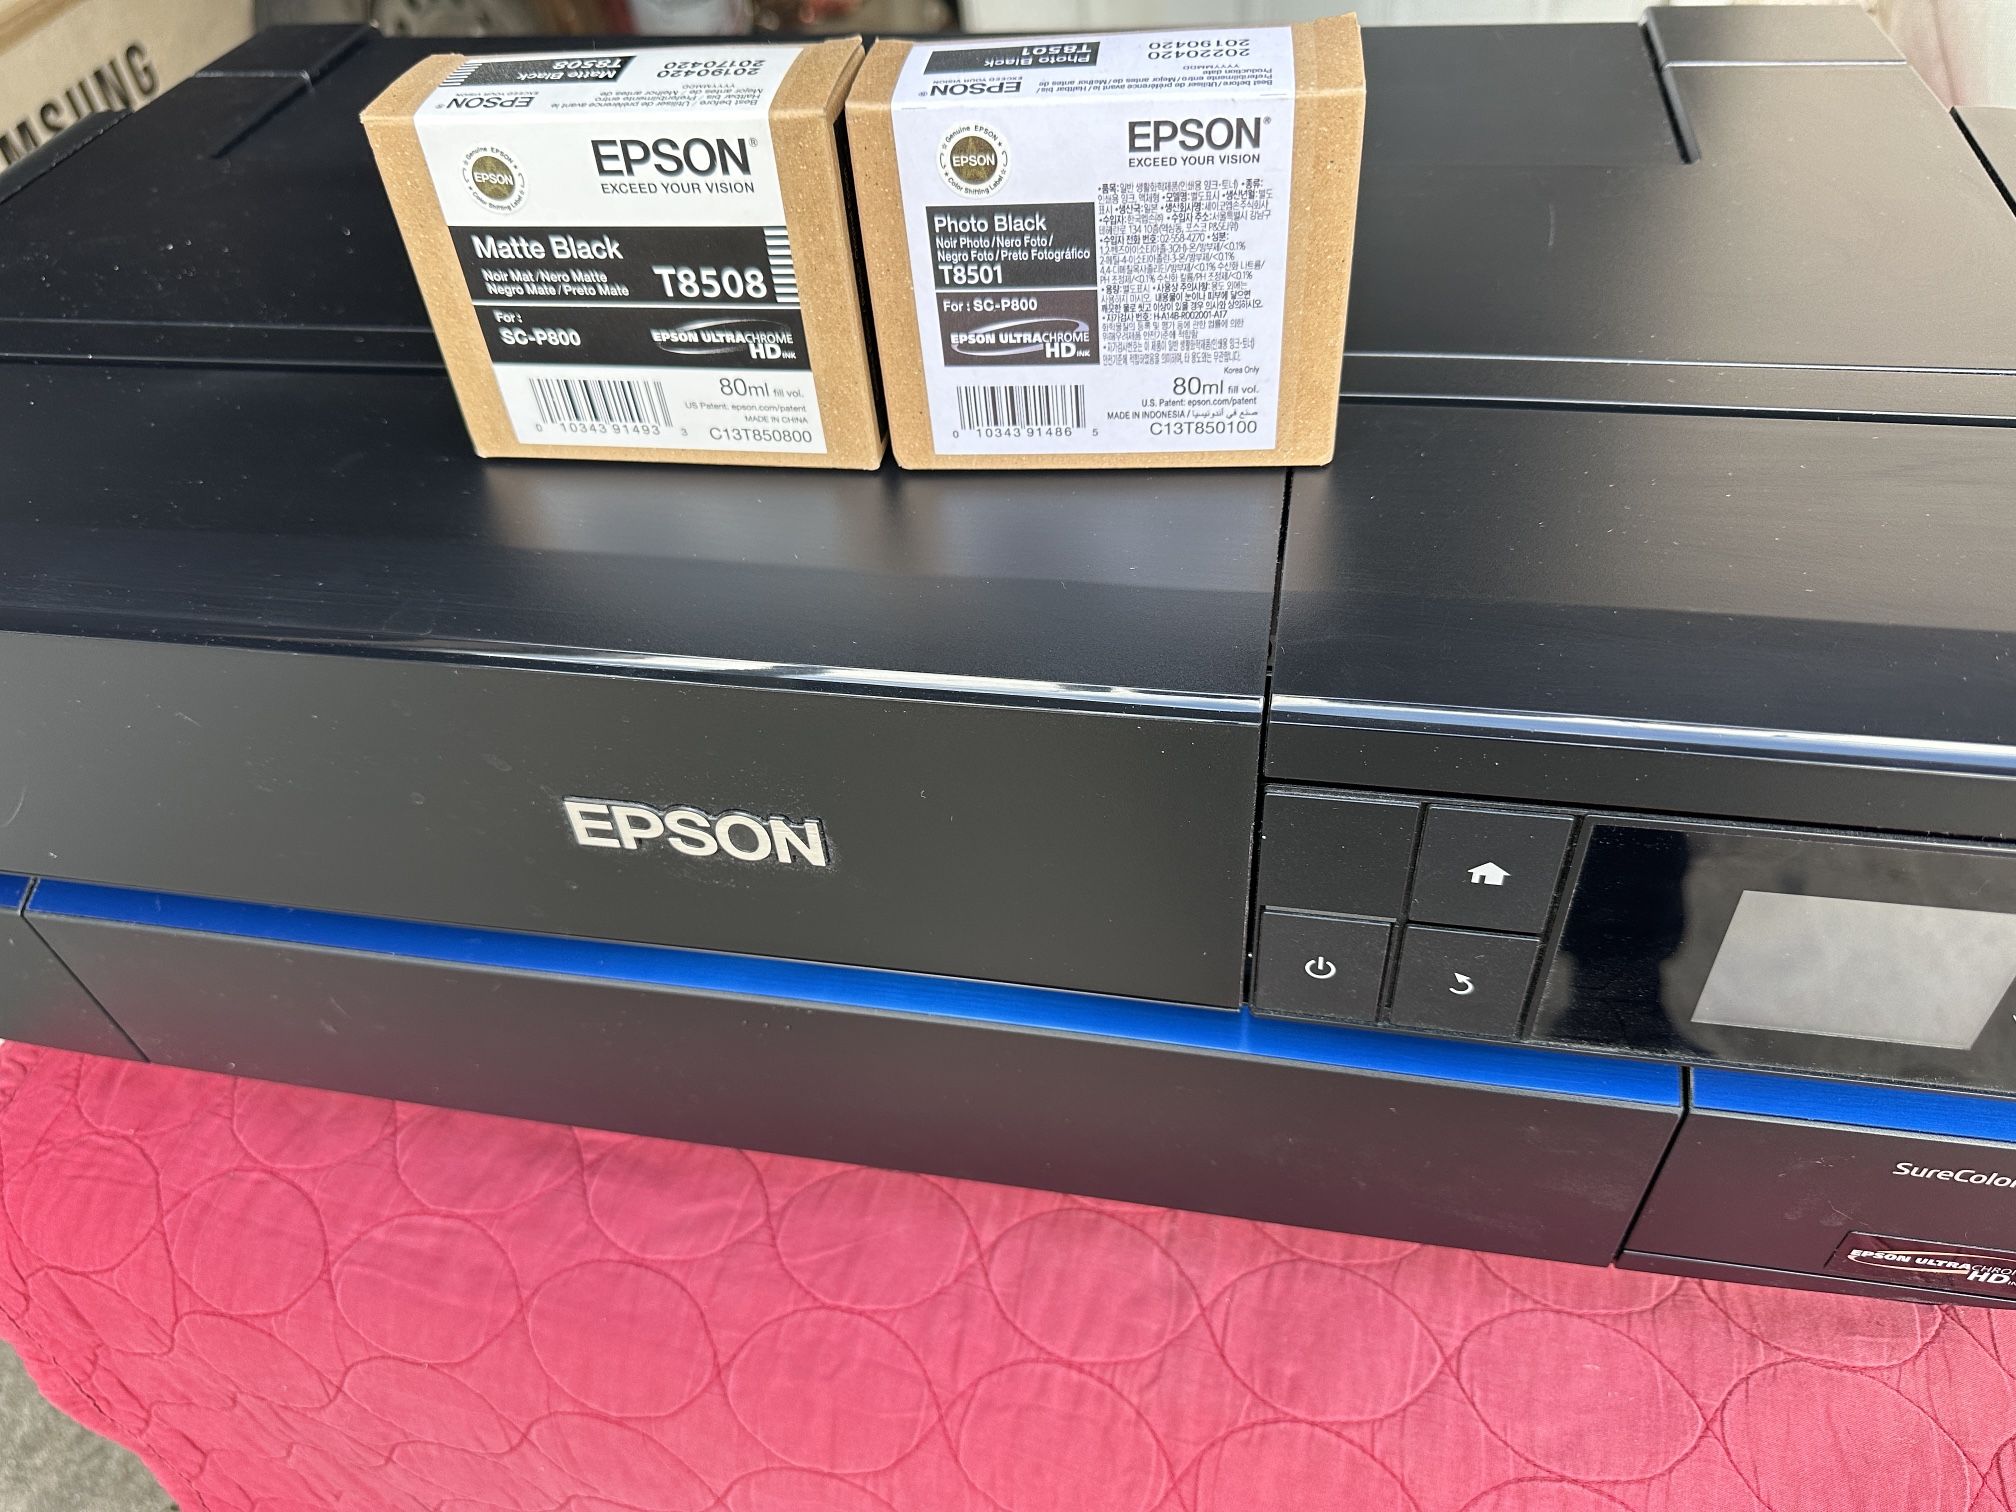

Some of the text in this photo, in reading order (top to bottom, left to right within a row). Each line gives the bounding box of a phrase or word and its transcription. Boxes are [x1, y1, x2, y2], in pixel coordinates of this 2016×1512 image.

[1021, 43, 1092, 56] T8501
[1148, 38, 1250, 50] 20190420
[983, 53, 1090, 68] Photo Black
[1147, 48, 1250, 60] 20220420
[552, 58, 622, 70] T8508
[664, 60, 766, 70] 20170420
[516, 69, 617, 81] Matte Black
[656, 67, 761, 78] 20190420
[945, 124, 999, 143] Genuine EPSON
[952, 153, 996, 167] EPSON
[1128, 153, 1261, 168] EXCEED YOUR VISION
[474, 171, 514, 186] EPSON
[947, 177, 964, 192] Color
[988, 175, 1004, 191] Label
[600, 182, 755, 194] EXCEED YOUR VISION
[934, 211, 1047, 233] Photo Black
[471, 234, 624, 260] Matte Black
[935, 235, 957, 249] Noir
[937, 250, 969, 264] Negro
[1030, 246, 1090, 263] Fotográfico
[480, 268, 508, 282] Noir
[569, 268, 608, 283] Matte
[938, 263, 1003, 285] T8501
[485, 282, 525, 297] Negro
[597, 282, 630, 297] Mate
[651, 265, 767, 299] T8508
[973, 297, 1038, 312] SC-P800
[498, 327, 582, 346] SC-P800
[650, 328, 794, 345] EPSON ULTRACHROME
[950, 330, 1090, 344] EPSON ULTRACHROME
[748, 342, 796, 360] HD INK
[1045, 342, 1090, 359] HD INK
[1223, 365, 1260, 376] Korea Only
[719, 377, 770, 398] 80ml
[773, 388, 786, 398] fill
[1172, 376, 1260, 396] 80ml fill vol.
[685, 401, 698, 410] US
[731, 403, 807, 413] epson.com/patent
[1141, 398, 1157, 408] U.S.
[1187, 396, 1257, 408] epson.com/patent
[744, 415, 769, 423] MADE
[781, 416, 808, 424] CHINA
[1107, 409, 1186, 420] MADE IN INDONESIA
[535, 422, 689, 437] 0 10343 91493 3
[709, 427, 813, 443] C13T850800
[952, 426, 1099, 439] 0 10343 91486 5
[1150, 420, 1257, 436] C13T850100
[563, 797, 827, 867] EPSON
[1849, 1248, 1912, 1264] EPSON
[1966, 1270, 2011, 1285] HD
